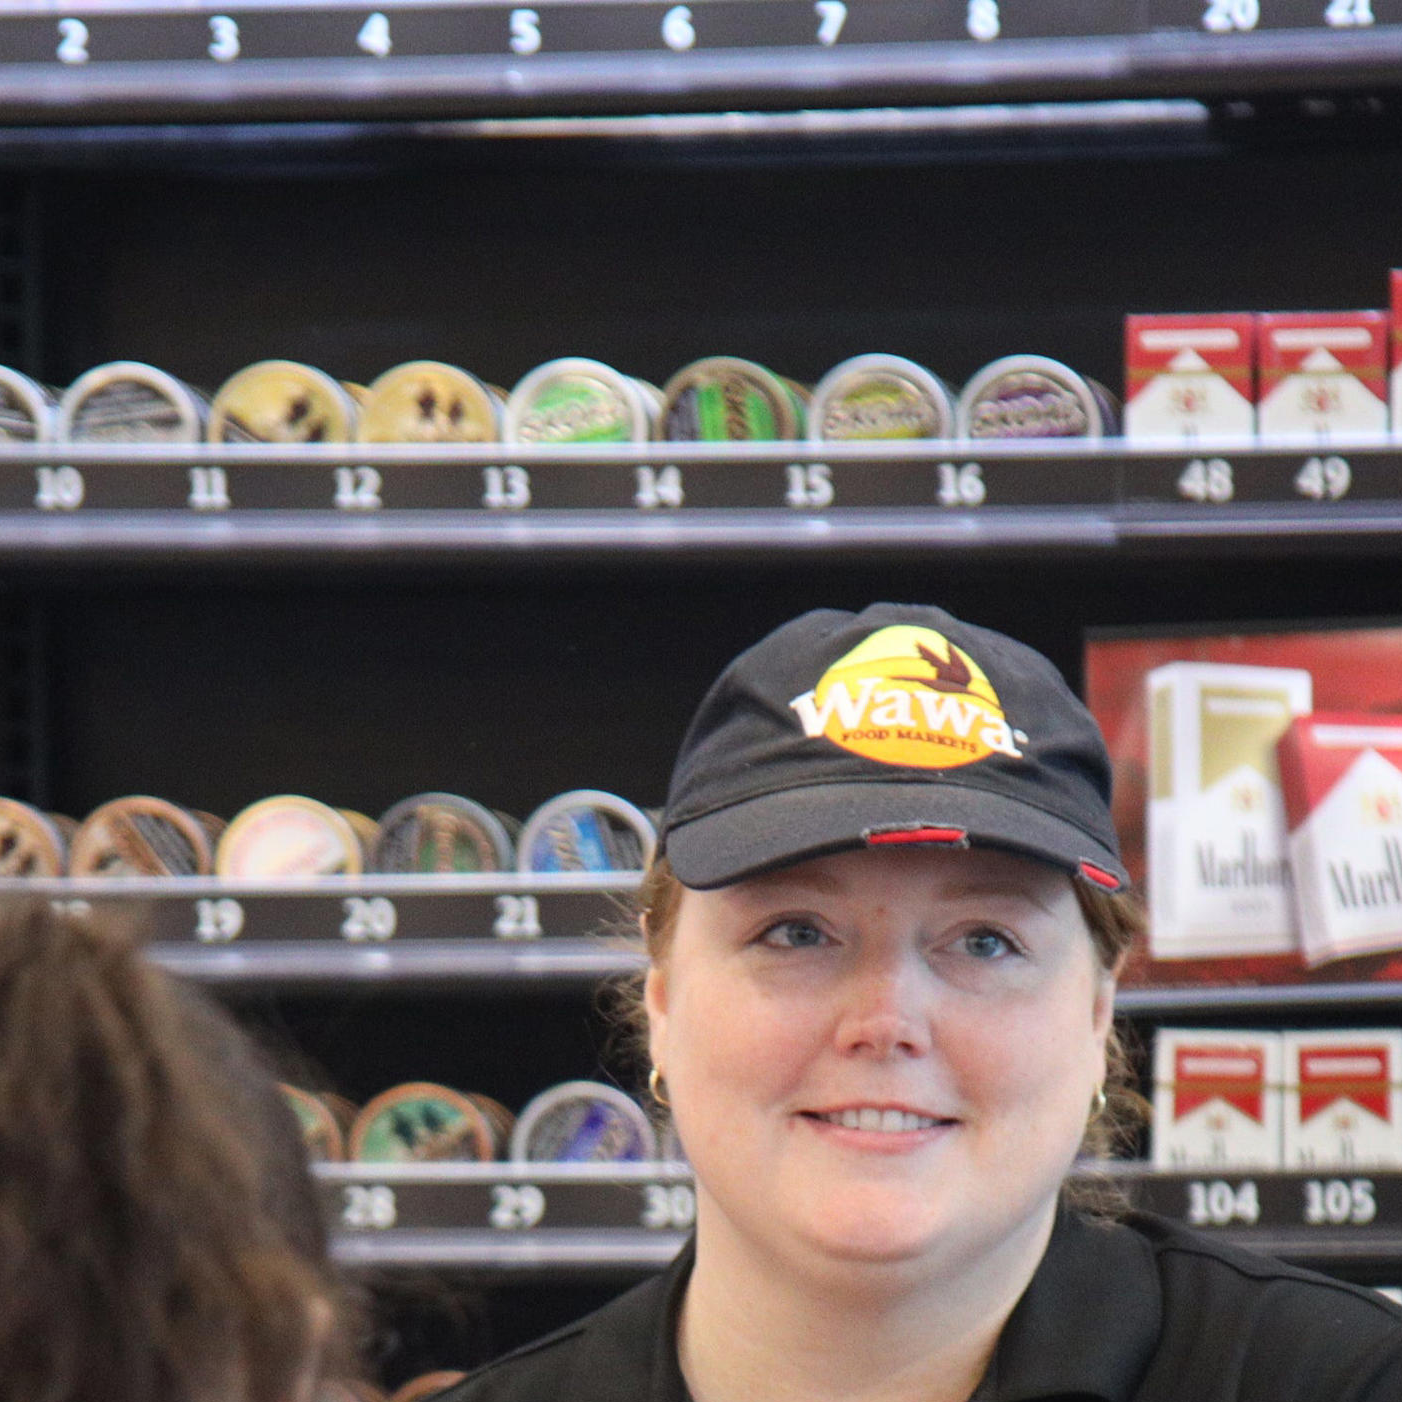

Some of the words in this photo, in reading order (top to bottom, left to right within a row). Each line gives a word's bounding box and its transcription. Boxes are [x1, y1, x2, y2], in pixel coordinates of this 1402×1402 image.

[57, 18, 89, 64] 2
[209, 15, 240, 60] 3
[357, 12, 392, 57] 4
[509, 7, 542, 54] 5
[662, 5, 695, 50] 6
[815, 0, 848, 45] 7
[967, 0, 1000, 41] 8
[34, 465, 85, 509] 10
[189, 465, 230, 509] 11
[335, 465, 383, 509] 12
[482, 464, 531, 510] 13
[634, 464, 685, 509] 14
[785, 462, 835, 508] 15
[935, 461, 986, 507] 16
[1178, 458, 1235, 502] 48
[1295, 456, 1353, 500] 49
[789, 678, 1024, 759] Wawa
[840, 726, 891, 744] FOOD
[897, 728, 979, 756] MARKETS
[195, 899, 244, 940] 19
[341, 898, 397, 940] 20
[494, 897, 541, 938] 21
[490, 1185, 546, 1229] 29
[1188, 1180, 1259, 1224] 104
[1304, 1180, 1377, 1224] 105
